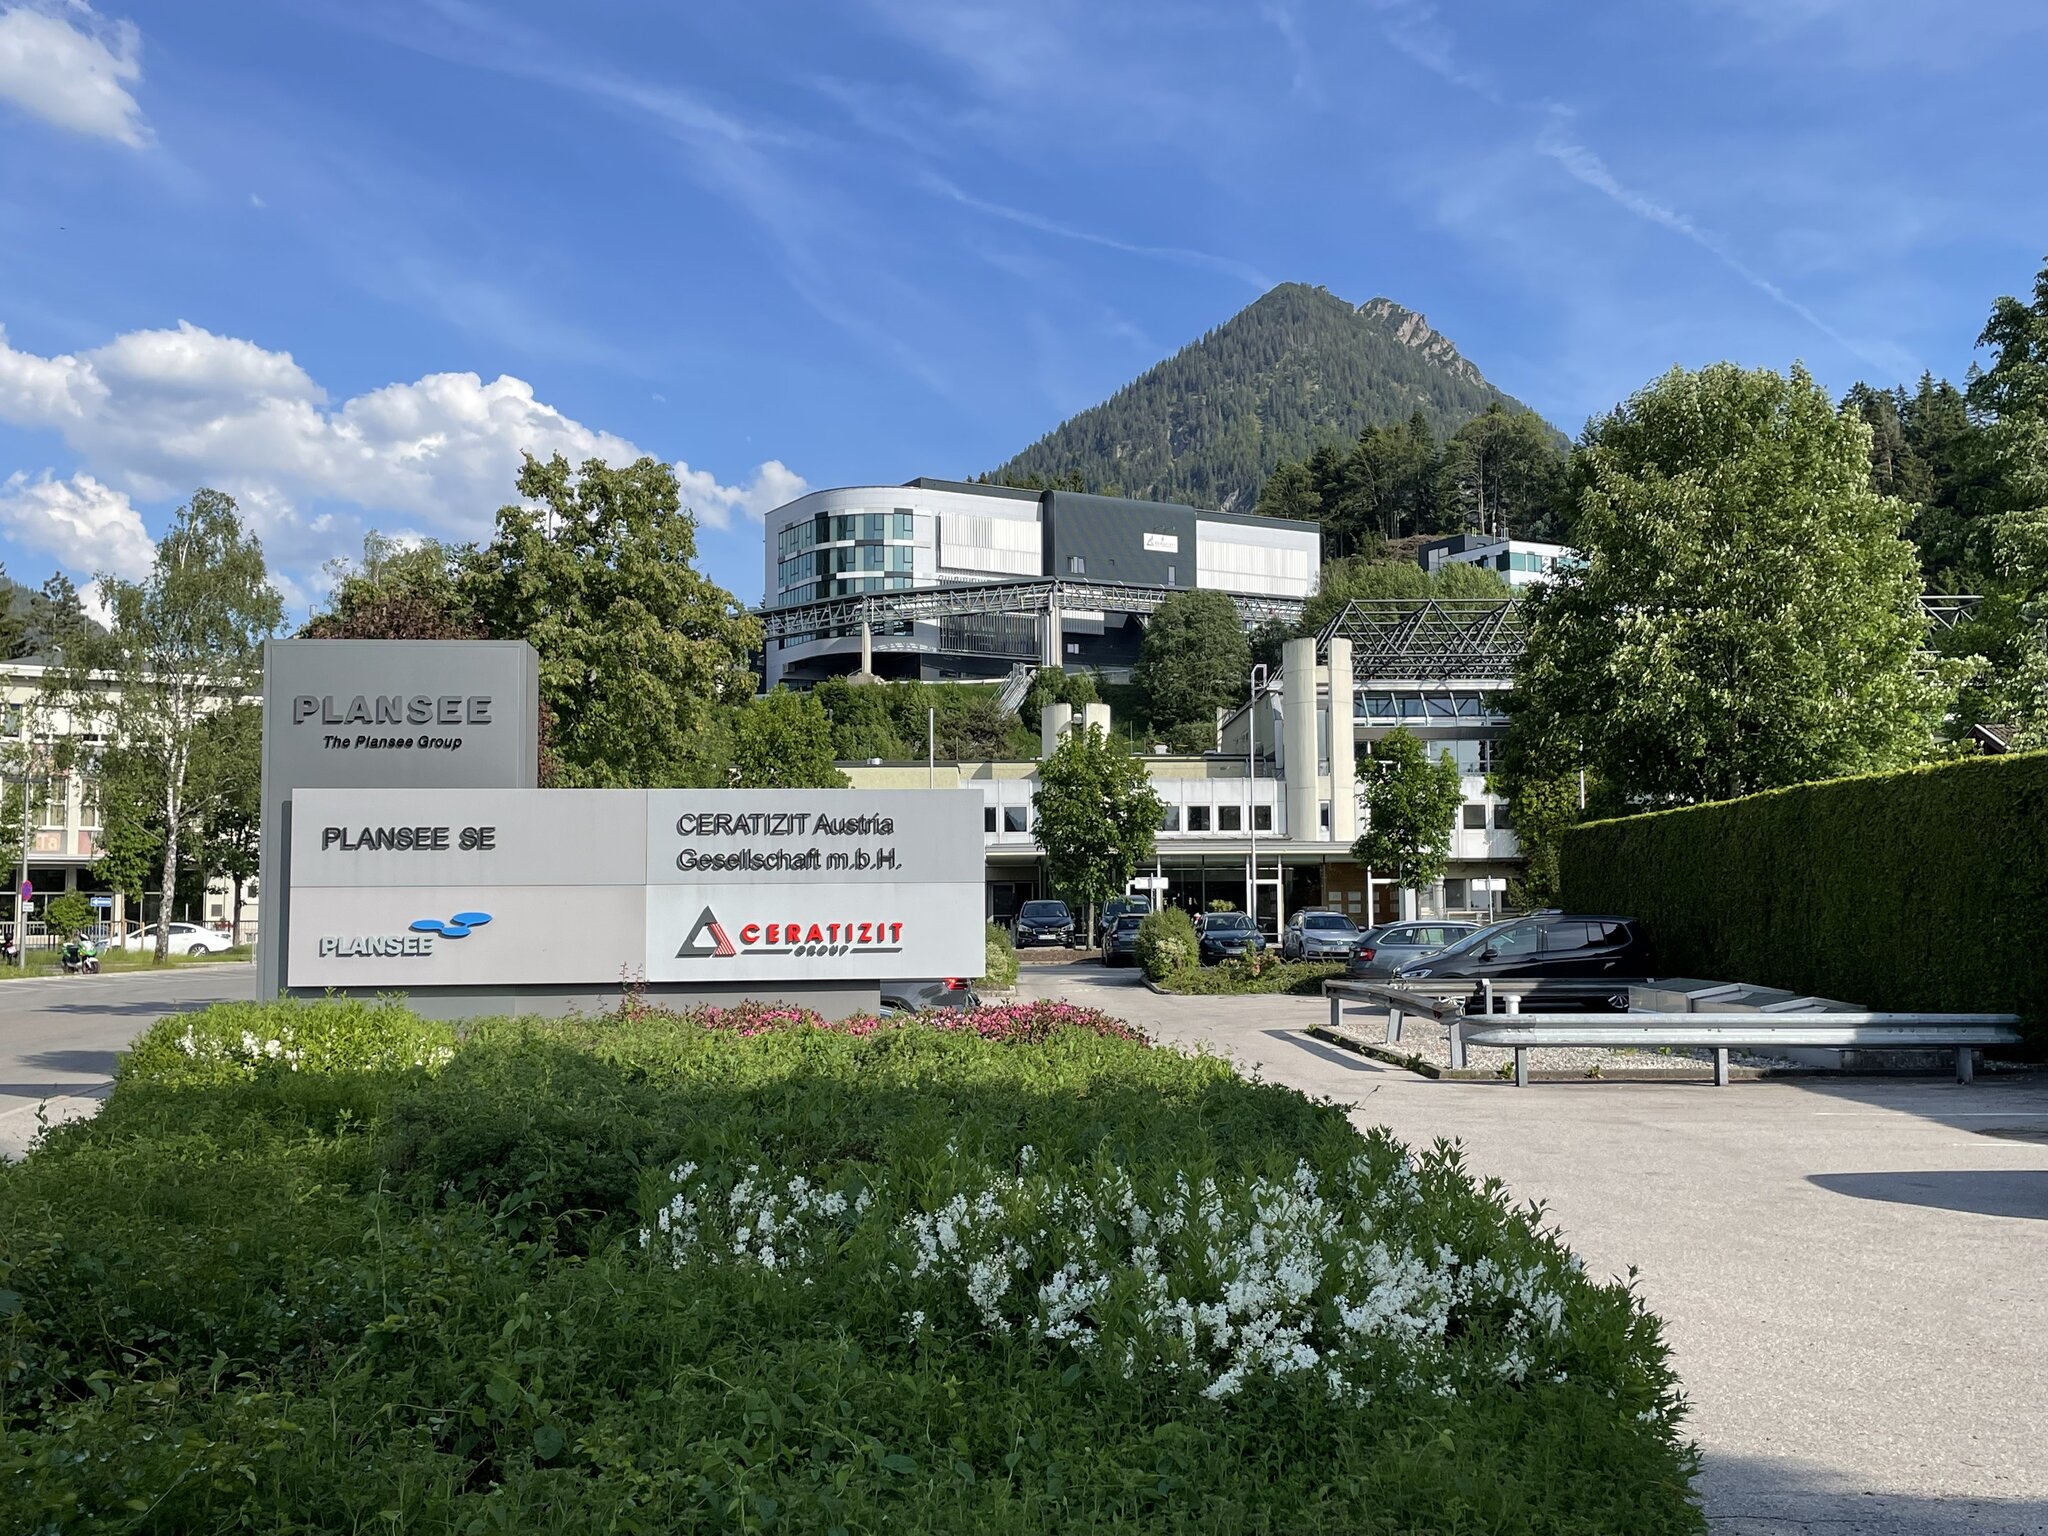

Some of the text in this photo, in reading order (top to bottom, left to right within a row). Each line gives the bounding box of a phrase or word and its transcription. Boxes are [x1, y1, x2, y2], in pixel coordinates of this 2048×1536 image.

[293, 695, 492, 725] PLANSEE
[323, 735, 462, 751] The Plansee Group
[676, 812, 894, 836] CERATIZIT Austria
[322, 827, 496, 851] PLANSEE SE
[676, 847, 902, 871] Gesellschaft m.b.H.
[740, 922, 903, 945] CERATIZIT
[319, 936, 434, 957] PLANSEE
[793, 945, 850, 957] GROUP
